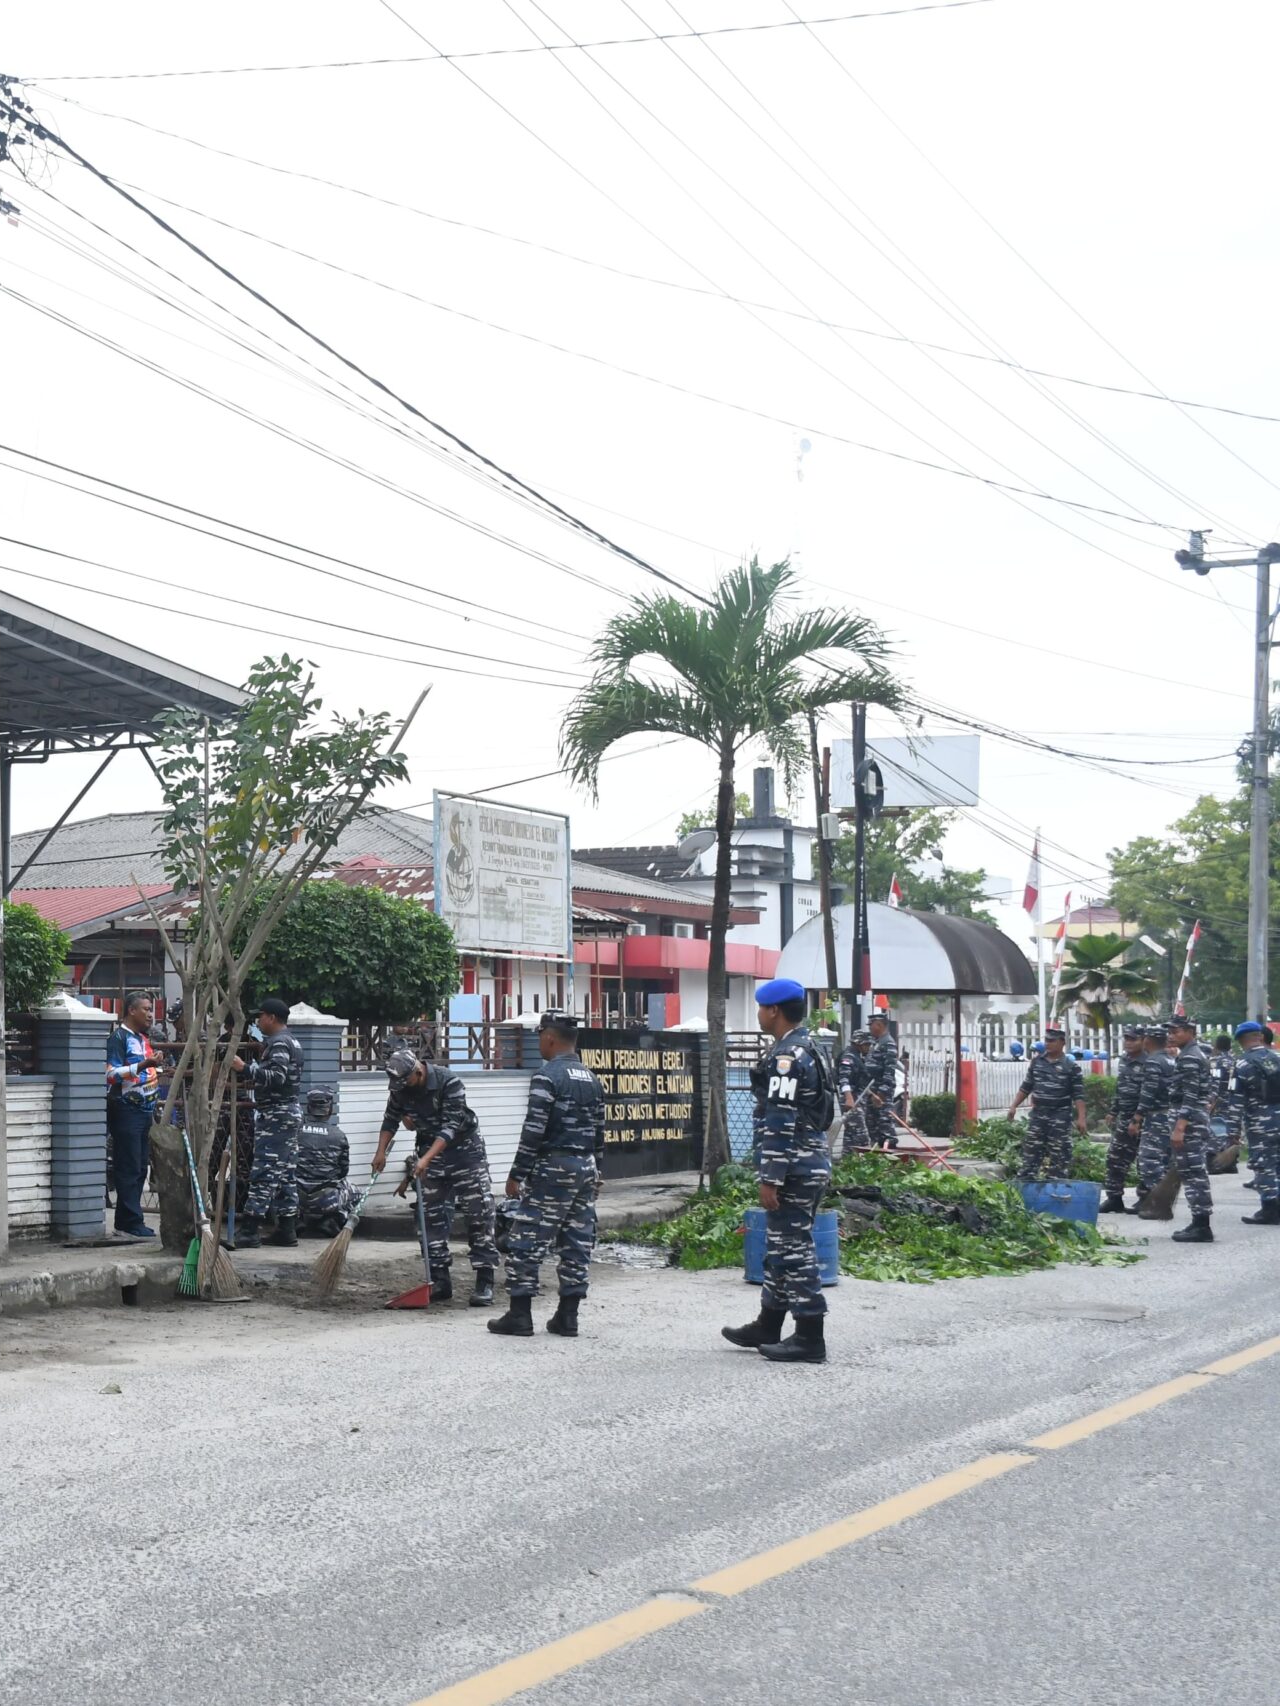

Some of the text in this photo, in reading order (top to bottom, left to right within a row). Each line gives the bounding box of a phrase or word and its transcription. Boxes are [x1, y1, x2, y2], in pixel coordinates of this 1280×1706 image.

[614, 1050, 659, 1070] PERGURUAN
[768, 1076, 798, 1101] PM
[627, 1103, 653, 1120] SWASTA
[655, 1103, 692, 1119] METHODIST
[303, 1125, 328, 1134] LANAL
